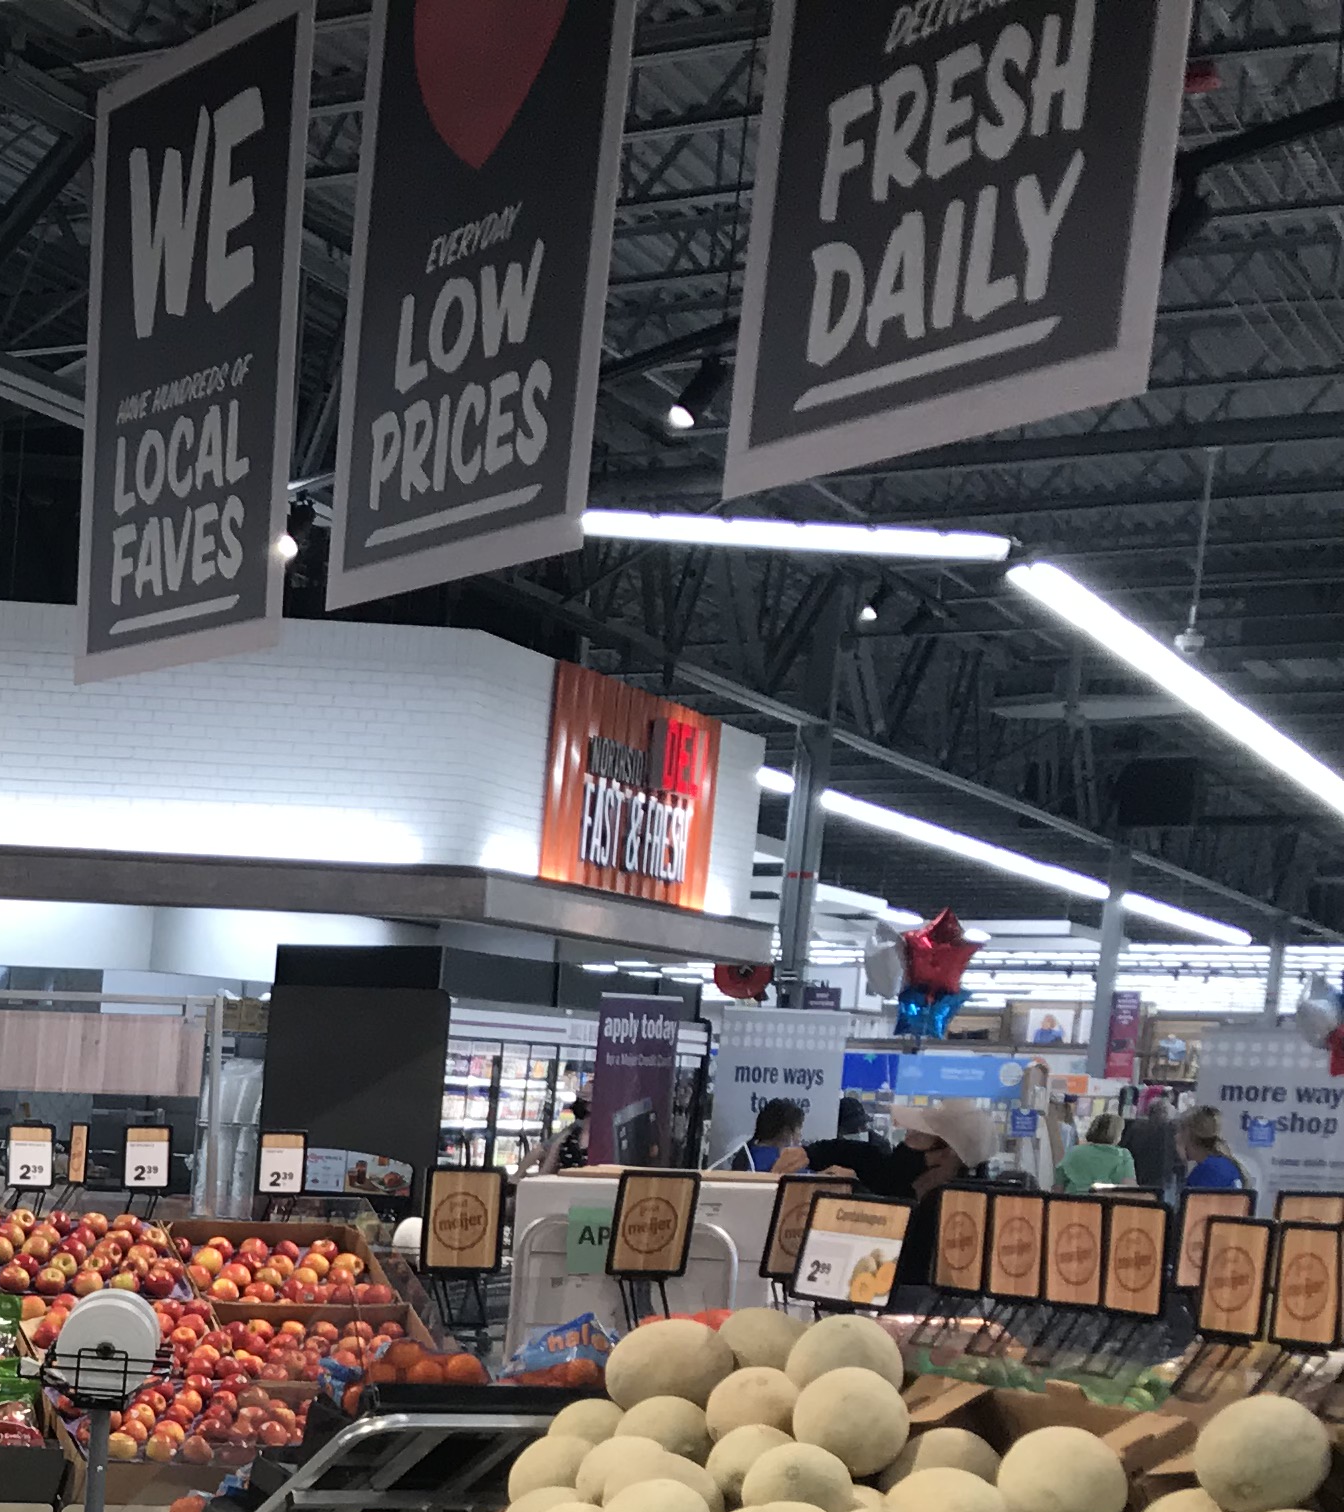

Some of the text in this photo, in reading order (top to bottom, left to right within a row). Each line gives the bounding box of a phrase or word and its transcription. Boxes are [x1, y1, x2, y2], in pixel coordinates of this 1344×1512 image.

[820, 14, 1092, 223] FRESH
[128, 86, 266, 340] WE
[424, 201, 523, 275] EVERYDAY
[807, 150, 1086, 368] DAILY
[394, 238, 545, 394] LOW
[114, 400, 250, 516] LOCAL
[368, 359, 554, 512] PRICES
[111, 494, 244, 606] FAVES
[580, 774, 694, 884] FAST & FRESH
[603, 1012, 677, 1046] apply today
[734, 1065, 825, 1090] more ways
[1220, 1084, 1344, 1110] more way
[1275, 1111, 1338, 1139] shop
[438, 1211, 483, 1233] meijer
